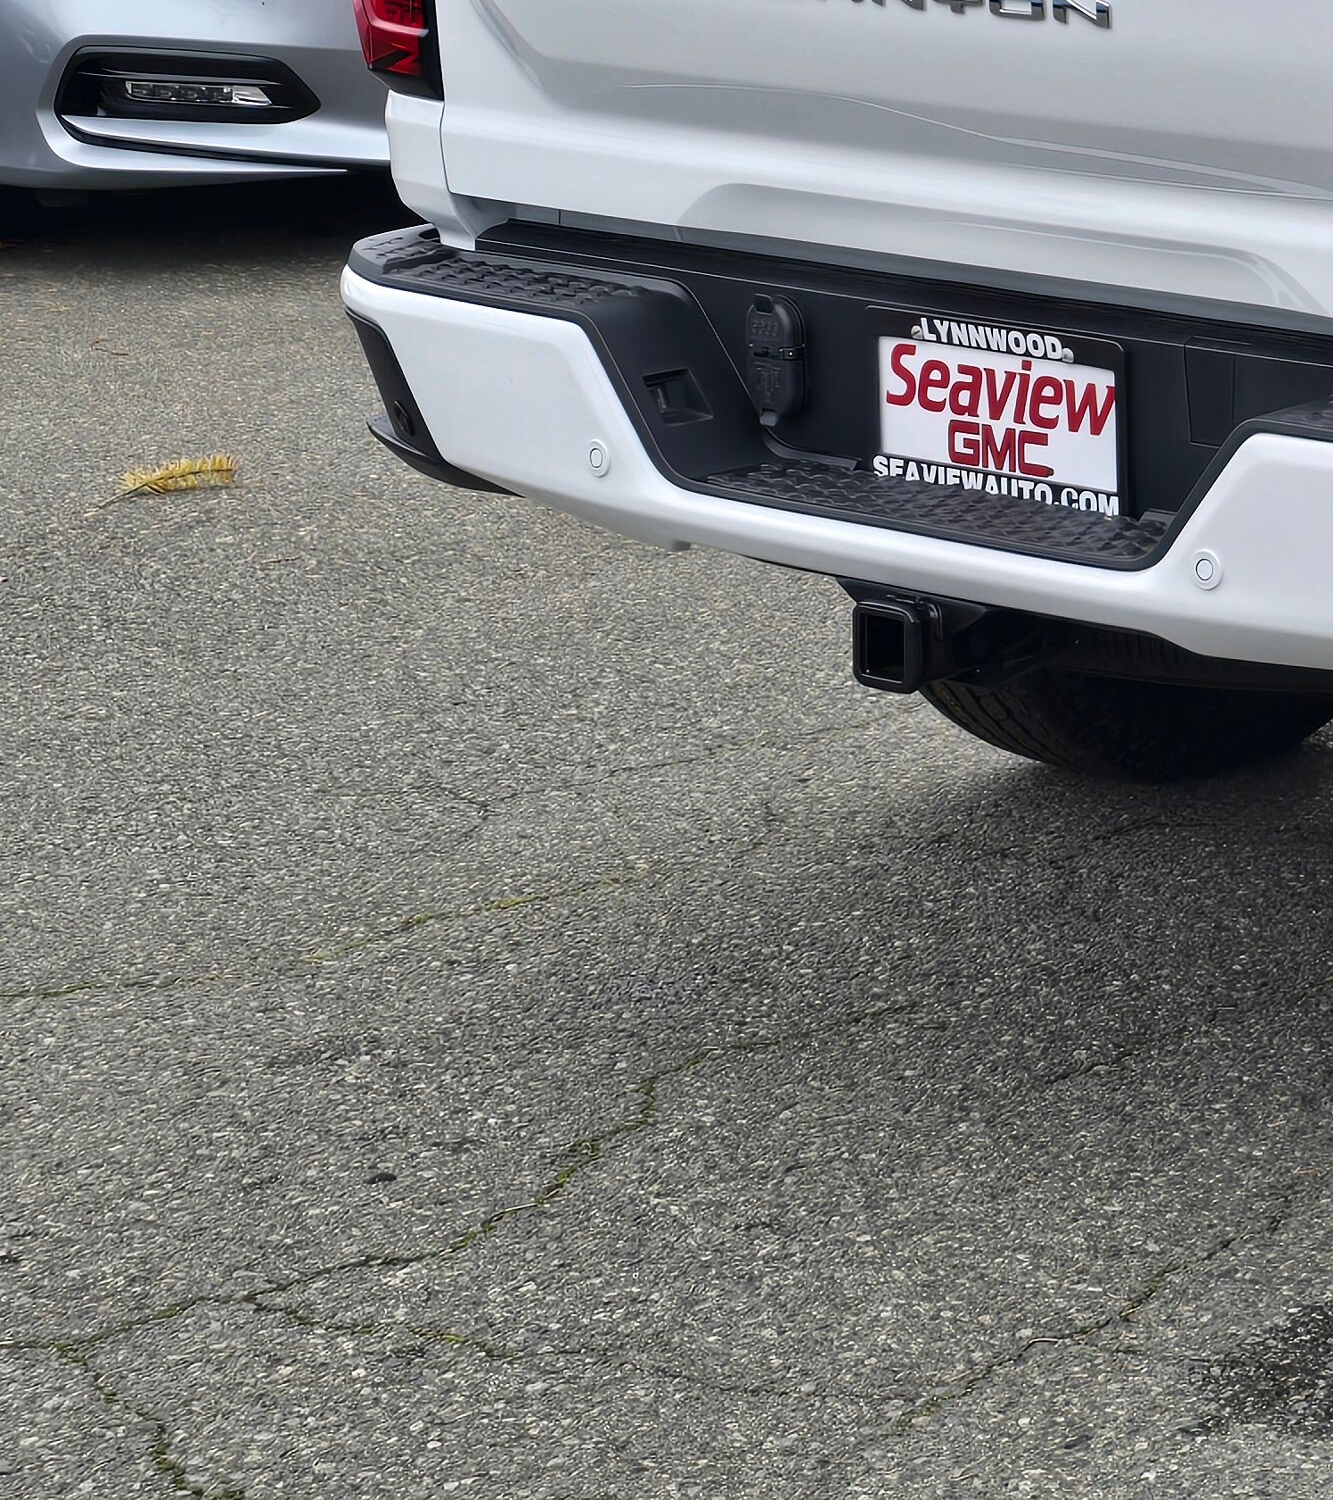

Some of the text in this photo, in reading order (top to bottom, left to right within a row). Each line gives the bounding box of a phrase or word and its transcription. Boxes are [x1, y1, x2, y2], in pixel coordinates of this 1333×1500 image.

[920, 317, 1063, 361] LYNNWOOD
[886, 343, 1115, 436] Seaview
[948, 419, 1054, 478] GMC
